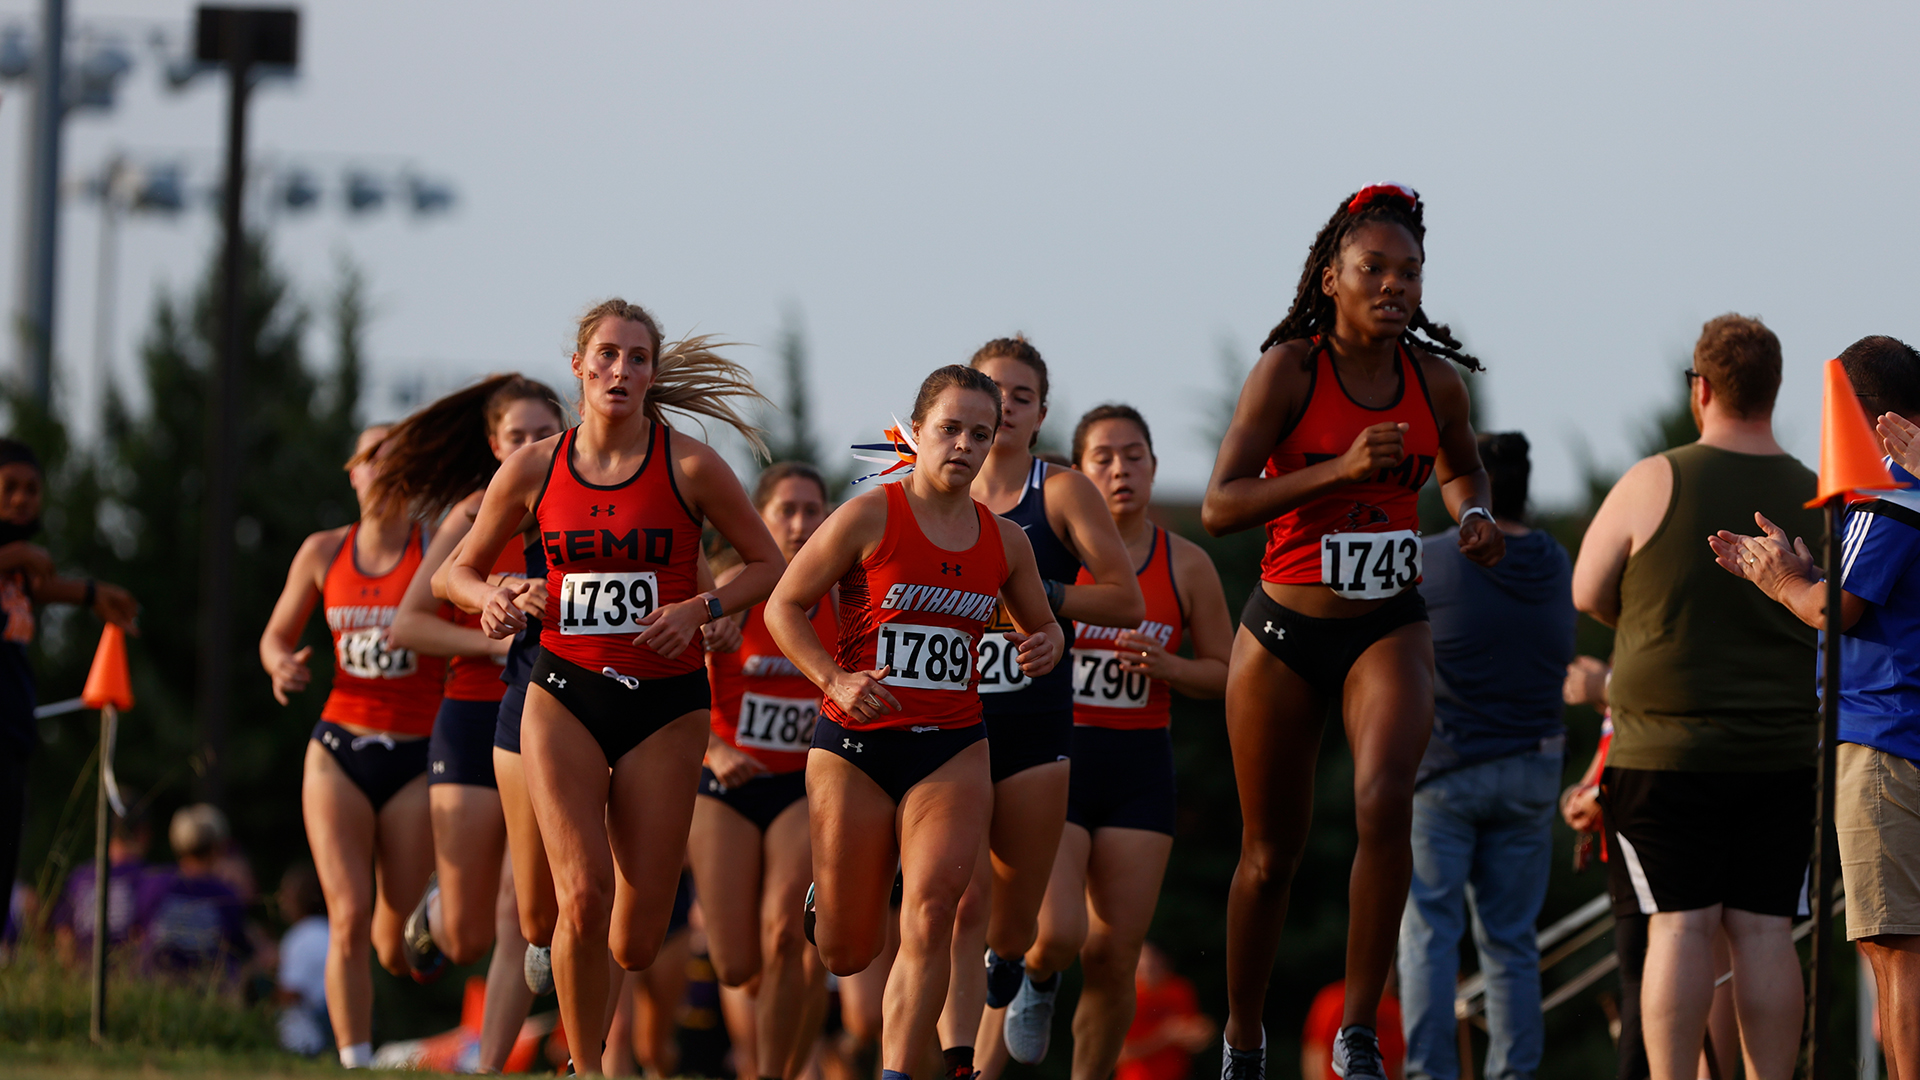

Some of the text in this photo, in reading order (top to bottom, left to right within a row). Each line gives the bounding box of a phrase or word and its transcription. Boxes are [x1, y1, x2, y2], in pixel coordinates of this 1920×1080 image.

[1303, 453, 1435, 493] MO
[543, 528, 673, 566] SEMO
[1325, 538, 1418, 591] 1743
[326, 605, 399, 631] SKYHAW
[563, 579, 654, 627] 1739
[881, 583, 997, 622] SKYHAWKS
[879, 629, 969, 683] 1789
[1072, 655, 1146, 701] 790
[741, 699, 815, 743] 1782
